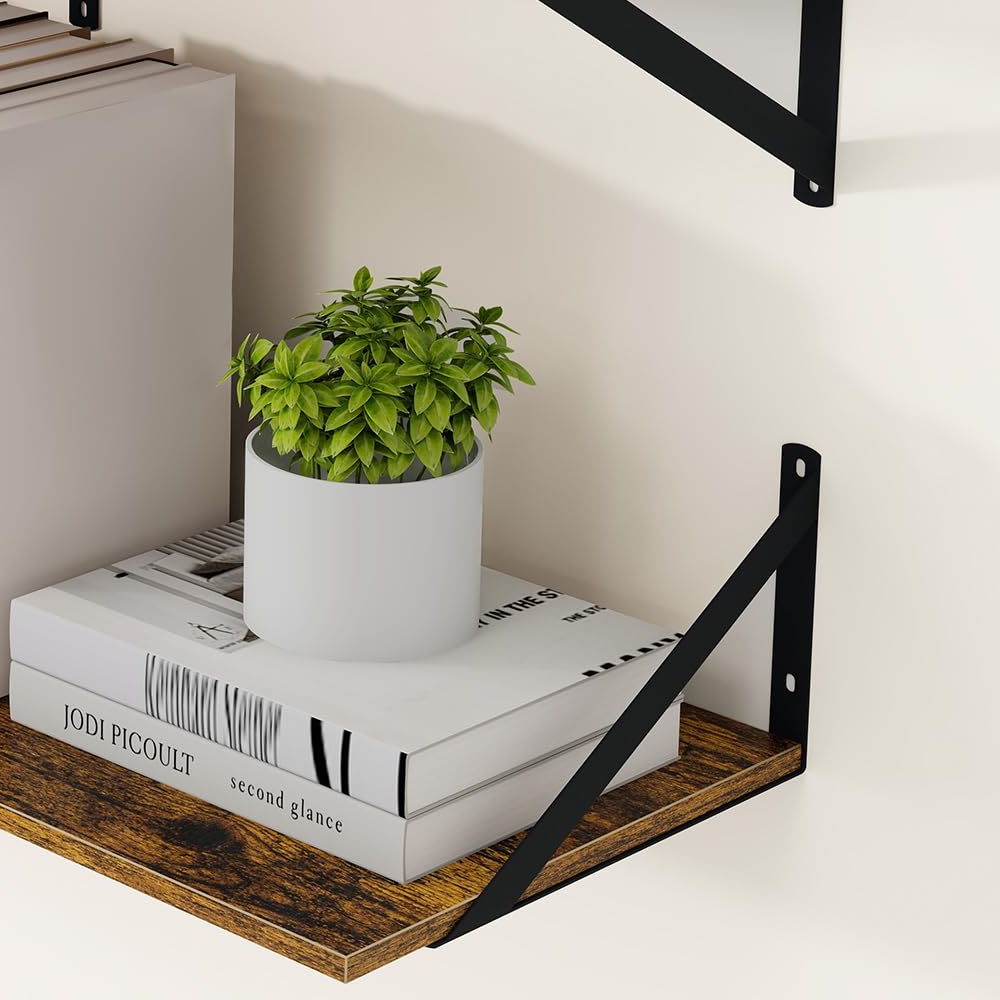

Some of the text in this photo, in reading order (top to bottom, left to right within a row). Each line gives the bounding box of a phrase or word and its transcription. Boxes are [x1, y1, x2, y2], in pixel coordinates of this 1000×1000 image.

[484, 608, 512, 620] IN
[502, 596, 545, 612] THE
[561, 613, 587, 622] THE
[64, 704, 195, 777] JODI PICOULT
[230, 776, 343, 833] second glance
